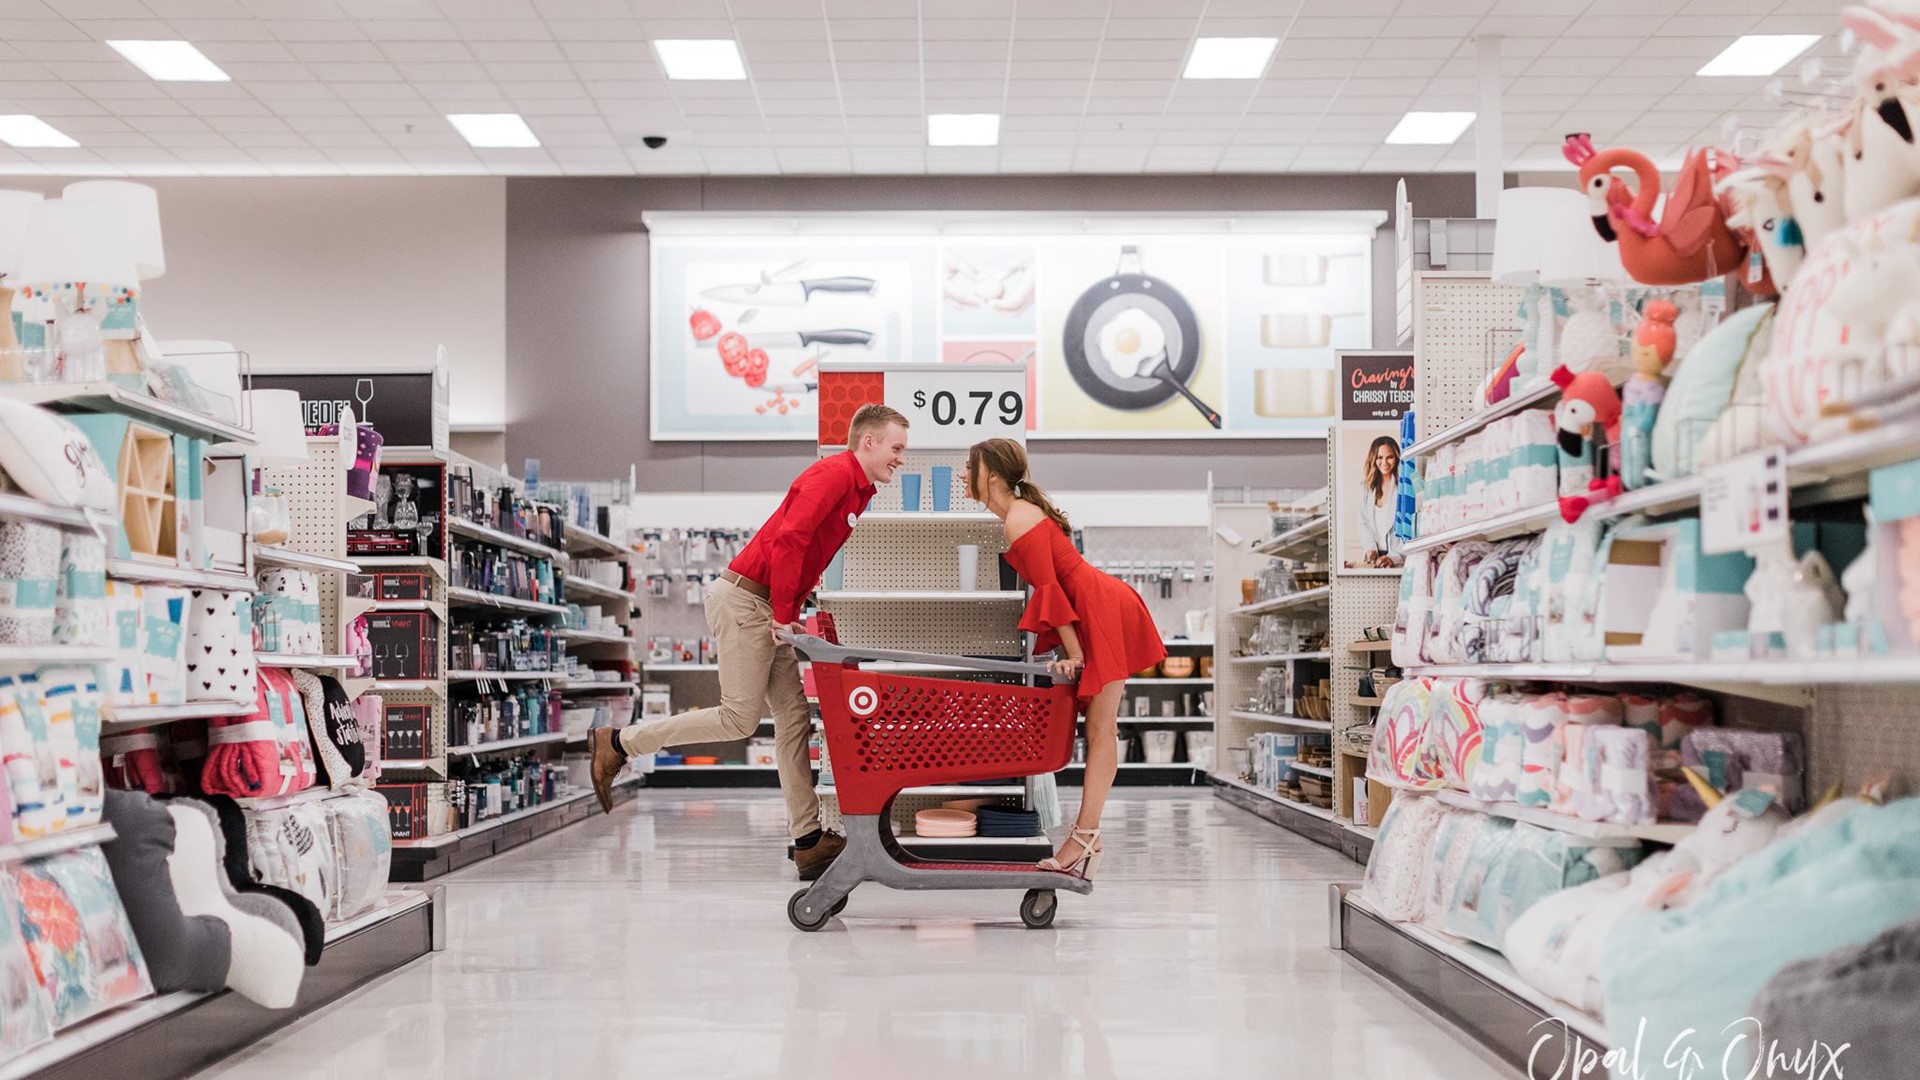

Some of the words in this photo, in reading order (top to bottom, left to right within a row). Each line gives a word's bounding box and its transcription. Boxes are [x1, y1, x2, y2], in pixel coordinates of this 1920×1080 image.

[1390, 380, 1397, 389] by
[1353, 390, 1387, 403] CHRISSY
[913, 389, 1023, 425] $0.79
[1372, 409, 1384, 417] only
